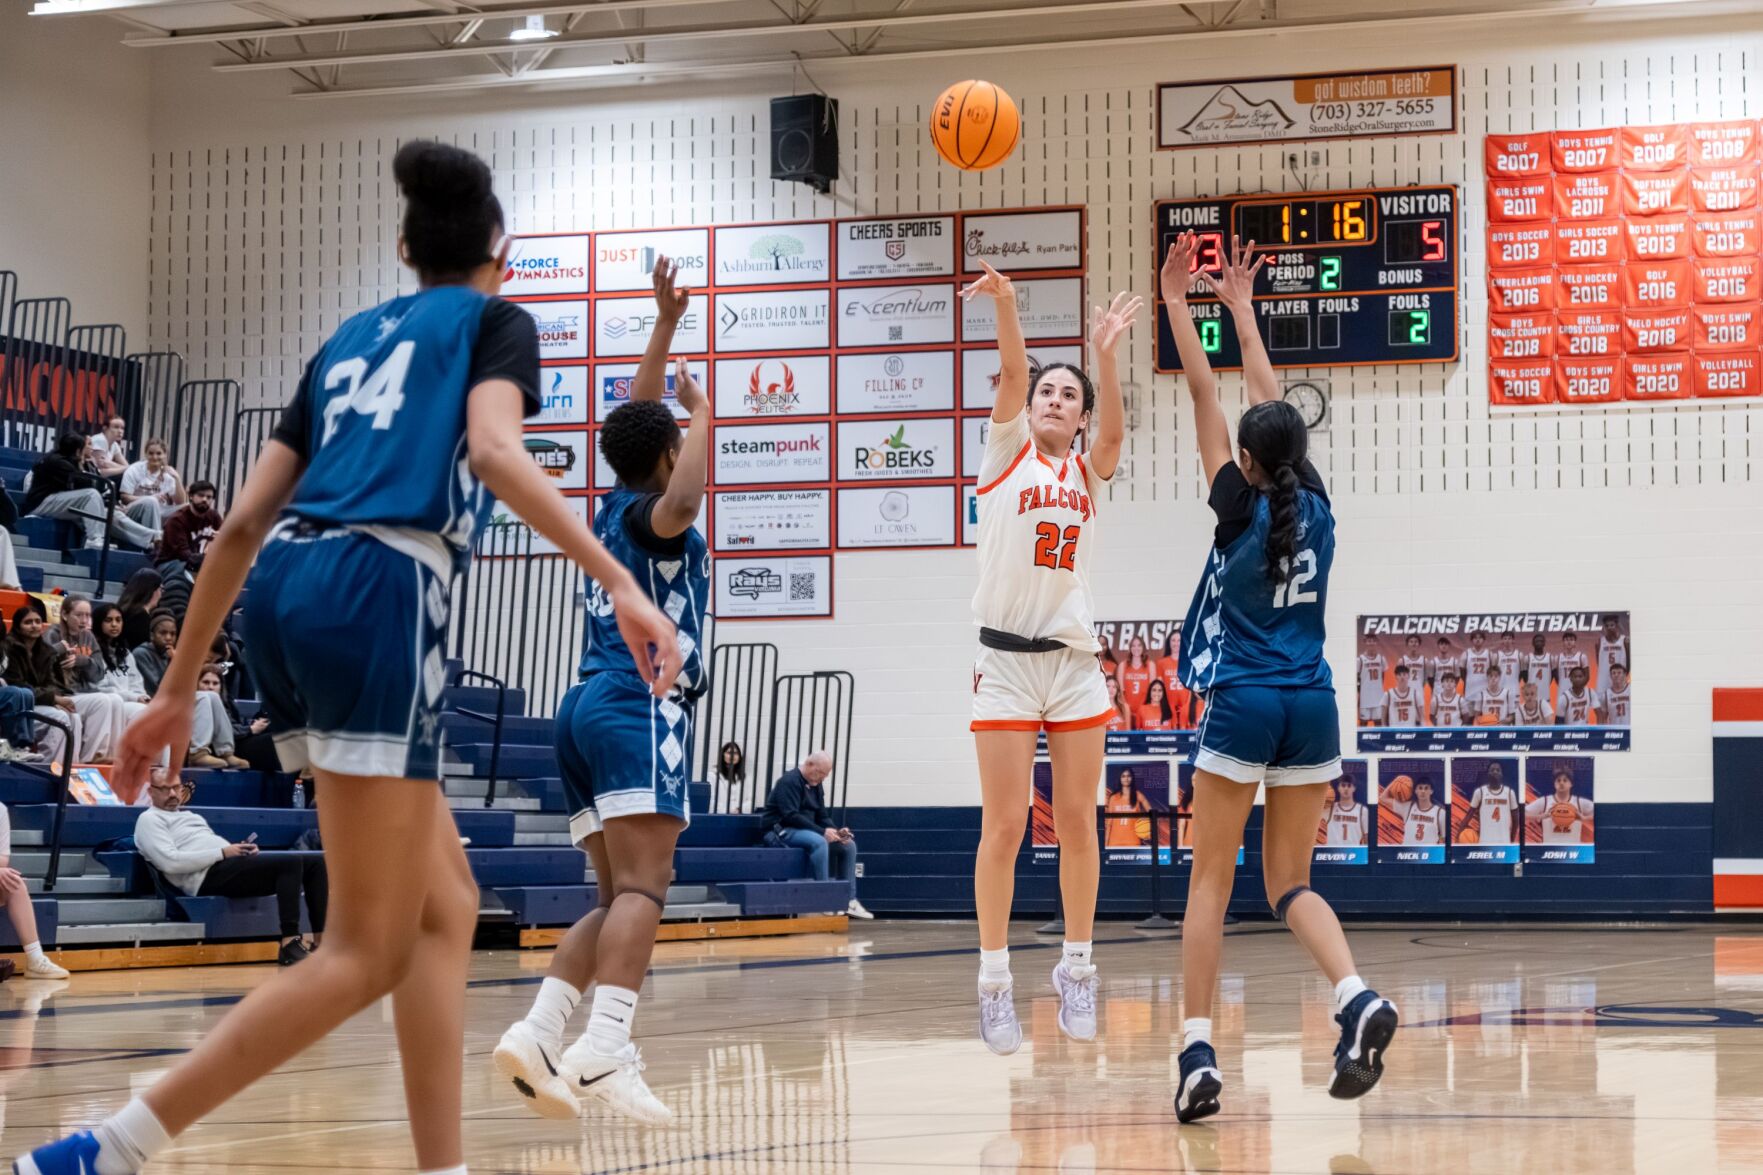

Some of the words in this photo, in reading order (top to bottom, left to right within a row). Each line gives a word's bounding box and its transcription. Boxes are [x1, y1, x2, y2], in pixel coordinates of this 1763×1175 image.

[1314, 80, 1334, 100] got
[1339, 77, 1387, 97] wisdom
[1392, 73, 1430, 95] teeth?
[1309, 104, 1352, 122] (703)
[1357, 98, 1435, 118] 327-5655
[1309, 120, 1435, 133] StoneRidgeOralSurgery.com
[1695, 130, 1718, 139] BOYS
[1721, 128, 1751, 138] TENNIS
[1558, 138, 1582, 148] BOYS
[1584, 135, 1613, 146] TENNIS
[1643, 134, 1664, 143] GOLF
[1507, 143, 1528, 151] GOLF
[1633, 144, 1675, 162] 2008
[1702, 140, 1744, 160] 2008
[1497, 153, 1539, 170] 2007
[1564, 150, 1606, 167] 2007
[1576, 178, 1599, 187] BOYS
[1633, 178, 1676, 189] SOFTBALL
[1692, 180, 1720, 189] TRACK
[1731, 178, 1755, 188] FIELD
[1711, 171, 1736, 181] GIRLS
[1496, 188, 1520, 196] GIRLS
[1522, 186, 1544, 195] SWIM
[1566, 186, 1608, 197] LACROSSE
[1380, 195, 1450, 215] VISITOR
[1503, 198, 1536, 215] 2011
[1638, 191, 1671, 208] 2011
[1706, 192, 1740, 208] 2011
[1571, 199, 1603, 216] 2011
[1169, 207, 1219, 226] HOME
[849, 223, 893, 241] CHEERS
[897, 220, 942, 238] SPORTS
[1559, 228, 1583, 238] GIRLS
[1585, 226, 1618, 237] SOCCER
[1629, 225, 1652, 234] BOYS
[1654, 223, 1684, 233] TENNIS
[1696, 222, 1721, 231] GIRLS
[1723, 220, 1754, 230] TENNIS
[1422, 221, 1444, 260] 5
[1492, 232, 1515, 242] BOYS
[1517, 230, 1549, 240] SOCCER
[1706, 233, 1744, 250] 2013
[1036, 244, 1057, 254] Ryan
[1058, 243, 1078, 253] Park
[1503, 243, 1539, 261] 2013
[1569, 239, 1607, 257] 2013
[1637, 236, 1675, 254] 2013
[599, 248, 639, 263] JUST
[1278, 253, 1304, 264] POSS
[719, 258, 773, 274] Ashburn
[781, 257, 827, 273] Allergy
[1701, 266, 1753, 277] VOLLEYBALL
[1267, 265, 1315, 280] PERIOD
[1321, 257, 1340, 290] 2
[1378, 270, 1423, 284] BONUS
[1492, 275, 1551, 286] CHEERLEADING
[1560, 275, 1583, 284] FIELD
[1585, 274, 1618, 283] HOCKEY
[1647, 271, 1667, 280] GOLF
[1571, 286, 1607, 303] 2016
[1639, 282, 1676, 300] 2016
[1707, 278, 1745, 296] 2016
[1388, 295, 1430, 309] FOULS
[1503, 289, 1539, 306] 2016
[740, 303, 809, 322] GRIDIRON
[814, 302, 827, 317] IT
[845, 298, 947, 316] Excentium
[1188, 304, 1221, 318] OULS
[1261, 300, 1309, 314] PLAYER
[1318, 298, 1359, 312] FOULS
[1511, 319, 1533, 328] BOYS
[1577, 315, 1601, 324] GIRLS
[1628, 318, 1651, 328] FIELD
[1654, 316, 1687, 327] HOCKEY
[1702, 314, 1726, 324] BOYS
[1728, 312, 1751, 322] SWIM
[1409, 312, 1429, 343] 2
[1492, 328, 1517, 337] CROSS
[1518, 326, 1552, 336] COUNTRY
[1559, 325, 1583, 334] CROSS
[1585, 324, 1620, 333] COUNTRY
[1708, 326, 1746, 344] 2018
[1201, 321, 1220, 352] 0
[1638, 328, 1676, 347] 2018
[1503, 340, 1539, 356] 2018
[1570, 336, 1607, 354] 2018
[1566, 367, 1589, 376] BOYS
[1591, 366, 1613, 375] SWIM
[1633, 364, 1657, 373] GIRLS
[1660, 363, 1683, 372] SWIM
[1701, 359, 1753, 370] VOLLEYBALL
[1494, 369, 1516, 378] GIRLS
[1518, 367, 1550, 377] SOCCER
[864, 378, 907, 392] FILLING
[1504, 379, 1540, 397] 2019
[1568, 378, 1610, 395] 2020
[1636, 375, 1679, 393] 2020
[1708, 371, 1746, 390] 2021
[0, 354, 116, 425] ALCONS
[321, 340, 416, 448] 24
[743, 392, 800, 406] PHOENIX
[758, 404, 785, 414] ELITE
[720, 433, 821, 458] steampunk
[855, 447, 935, 470] ROBEKS
[721, 493, 747, 502] CHEER
[777, 492, 793, 500] BUY
[1034, 521, 1081, 573] 22
[729, 574, 781, 587] Rays
[1273, 548, 1318, 608] 12
[1364, 617, 1460, 634] FALCONS
[1464, 614, 1603, 633] BASKETBALL
[1368, 669, 1379, 681] 10
[1473, 663, 1485, 674] 22
[1536, 669, 1543, 680] 4
[1132, 681, 1140, 694] 3
[1492, 806, 1500, 822] 4
[1415, 824, 1424, 841] 3
[1397, 852, 1419, 860] NICK
[1467, 851, 1494, 859] JEREL
[1496, 851, 1506, 859] M
[1542, 851, 1567, 859] JOSH
[1569, 851, 1579, 859] W
